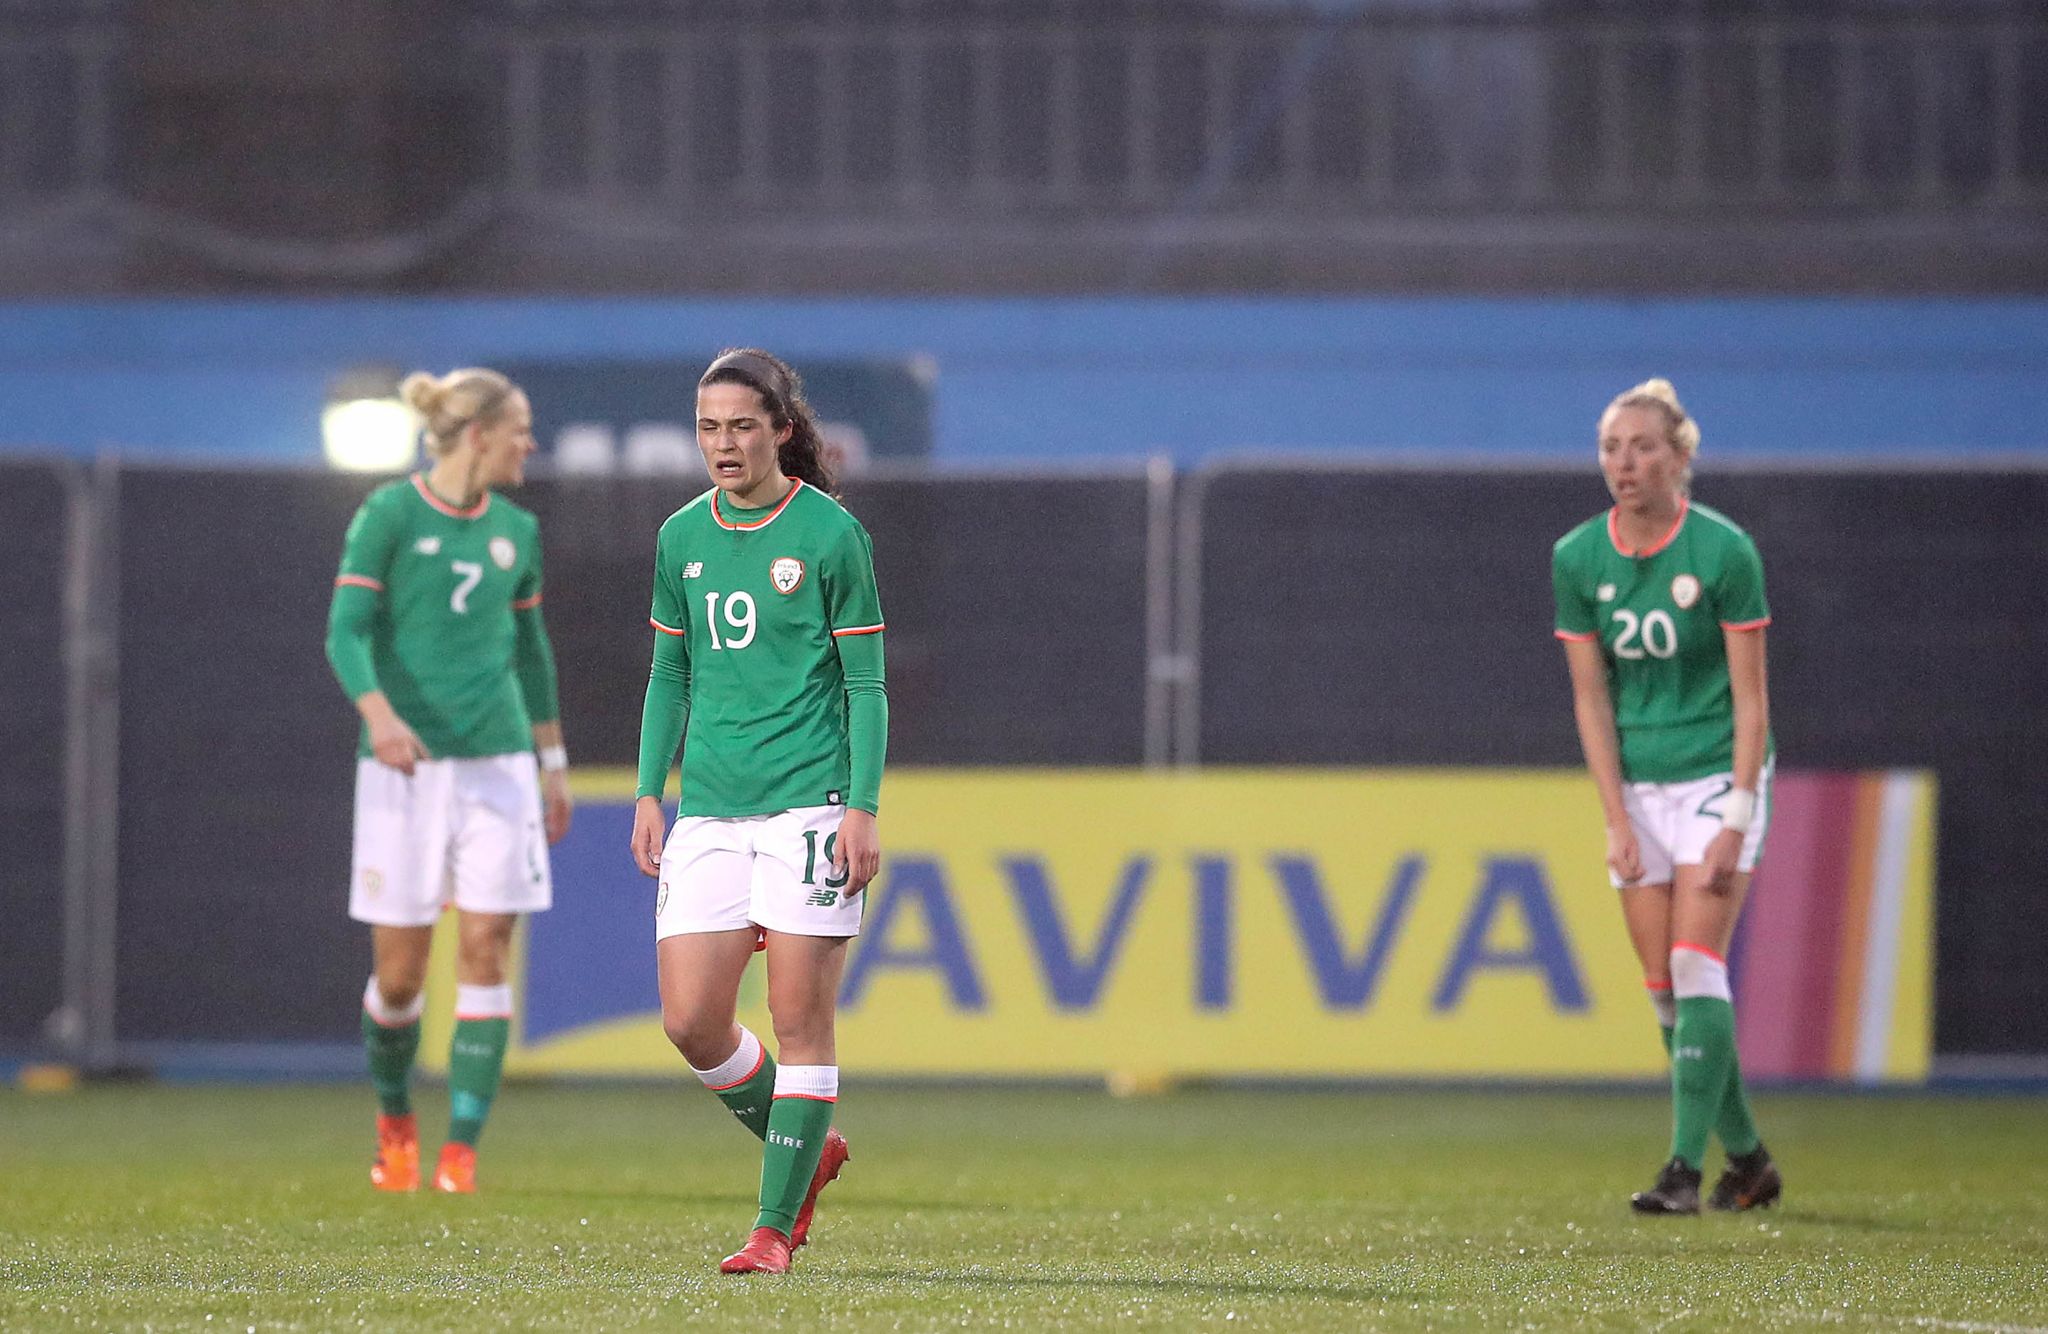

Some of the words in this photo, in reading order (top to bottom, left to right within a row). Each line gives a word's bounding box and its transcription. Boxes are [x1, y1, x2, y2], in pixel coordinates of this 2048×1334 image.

[451, 559, 483, 614] 7
[704, 590, 757, 650] 19
[1611, 608, 1678, 660] 20
[1695, 780, 1734, 819] 2
[837, 853, 1596, 1014] AVIVA
[769, 1129, 804, 1149] ÉIRE
